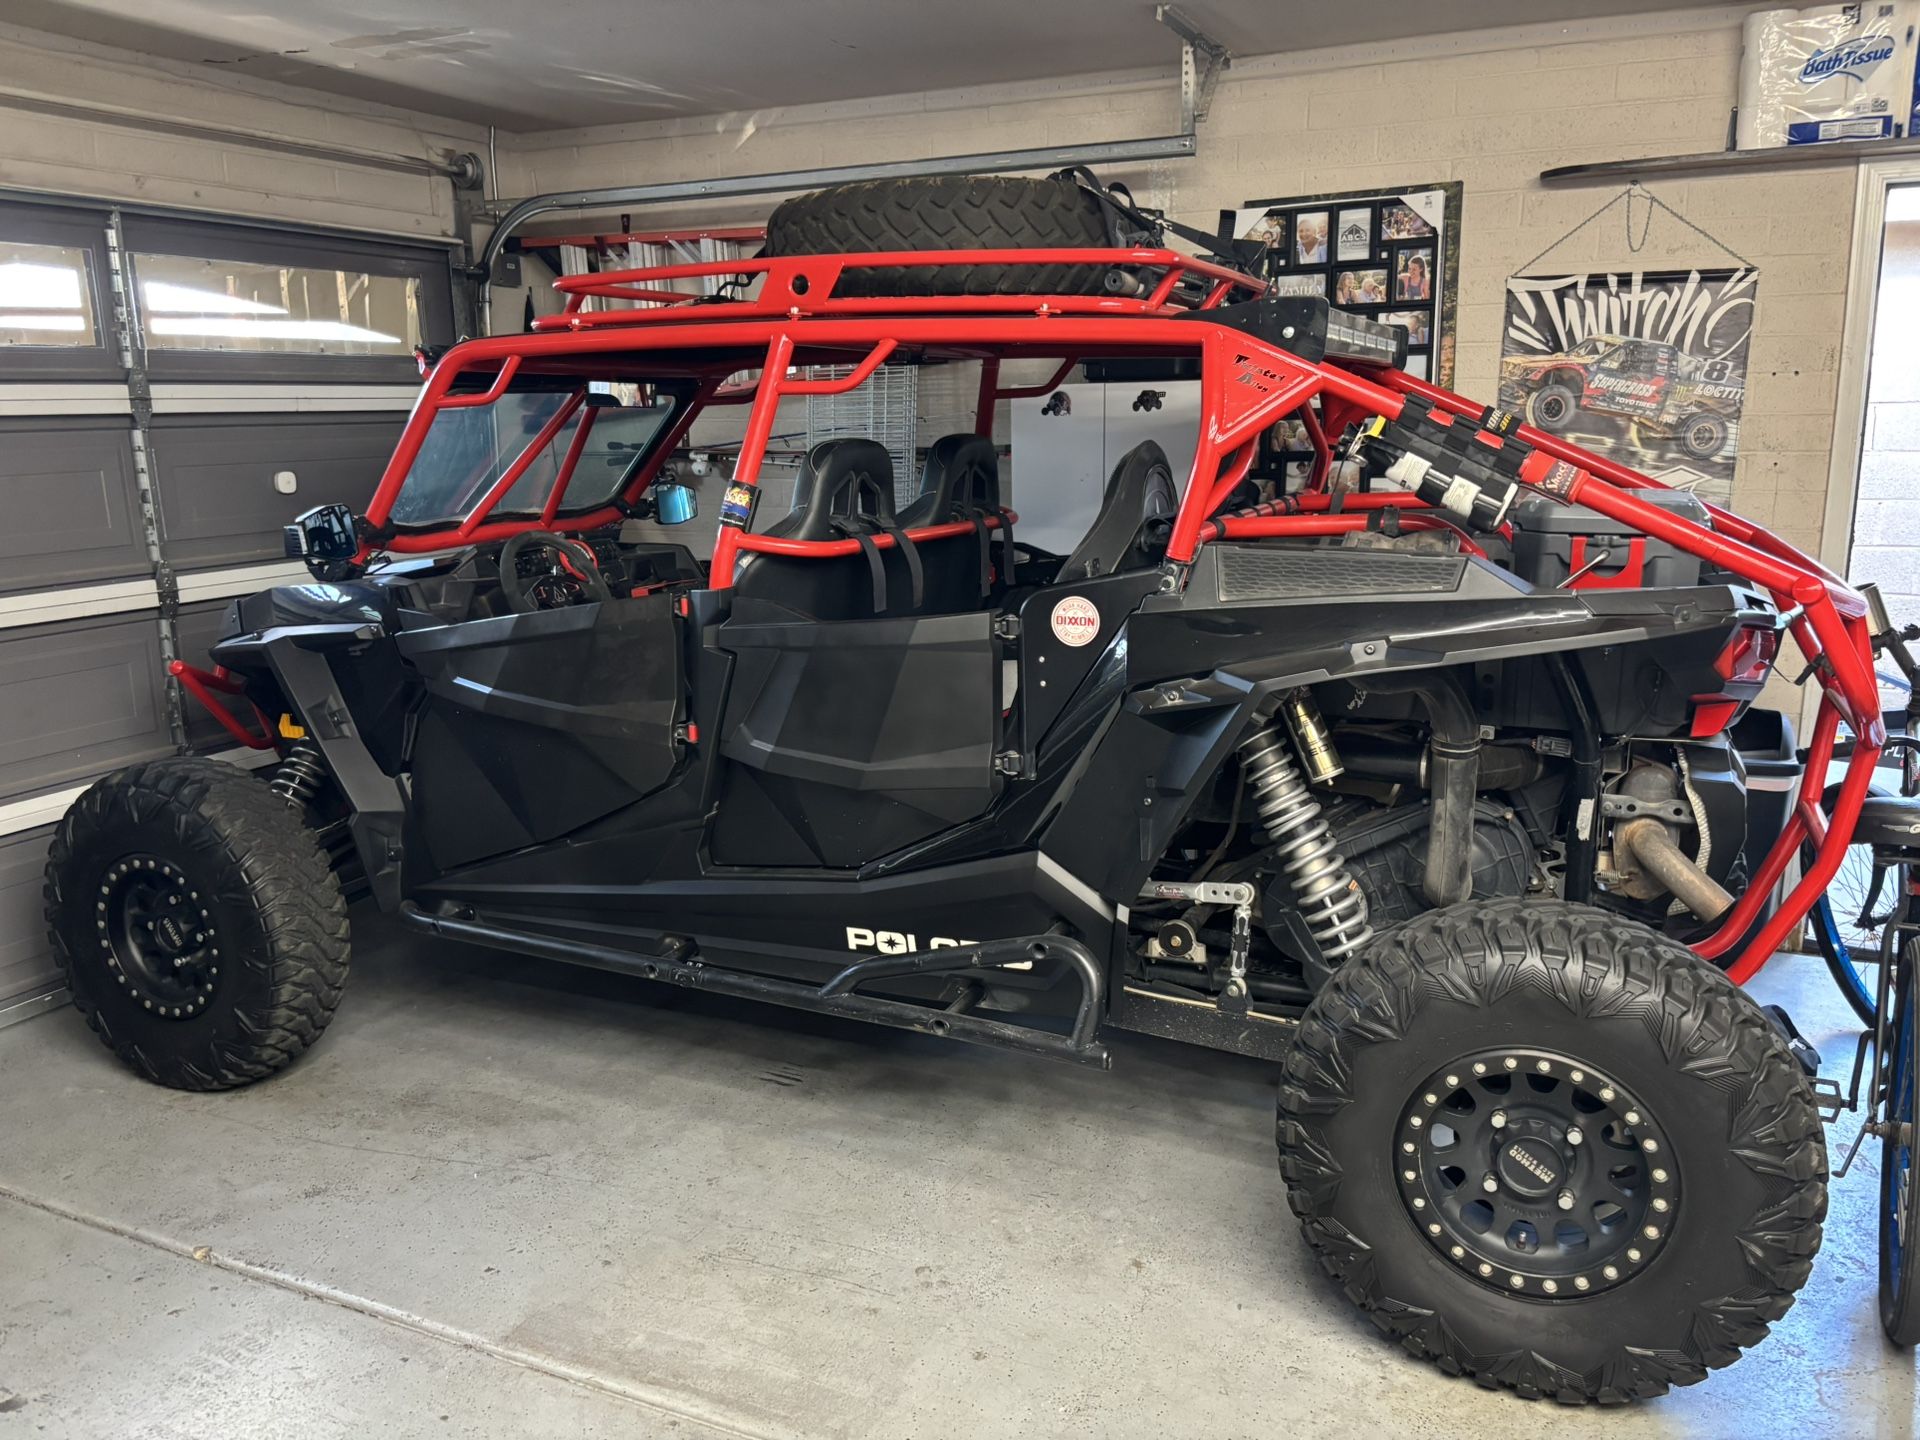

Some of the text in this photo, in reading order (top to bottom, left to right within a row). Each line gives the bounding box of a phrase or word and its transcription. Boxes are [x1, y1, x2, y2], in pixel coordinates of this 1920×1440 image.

[1803, 47, 1893, 76] Bath Tissue
[1703, 360, 1729, 382] 8
[1589, 373, 1657, 398] SUPERCROSS
[1056, 615, 1095, 627] DIXXON
[1509, 1149, 1552, 1184] METHOD
